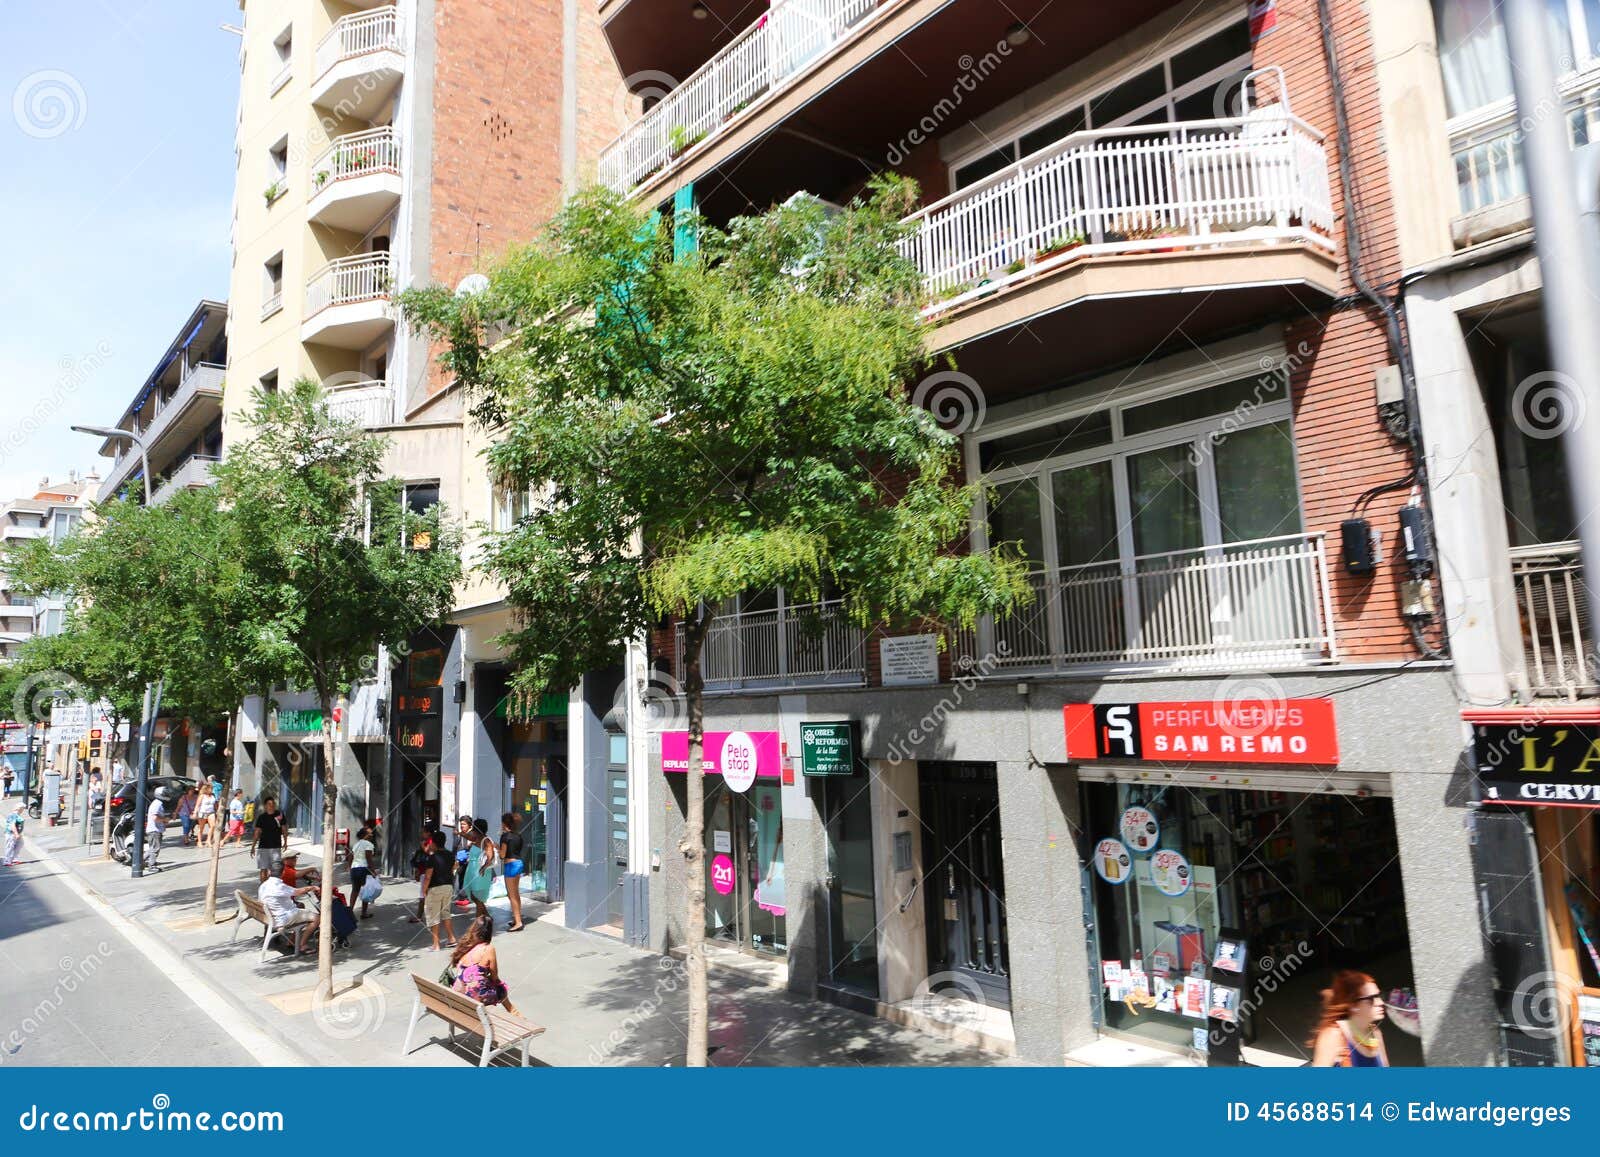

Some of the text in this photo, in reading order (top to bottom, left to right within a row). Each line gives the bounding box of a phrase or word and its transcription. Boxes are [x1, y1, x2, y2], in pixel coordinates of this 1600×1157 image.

[1153, 708, 1304, 727] PERFUMERIES
[815, 738, 849, 746] REFORMES
[1154, 735, 1308, 754] SAN REMO
[727, 744, 749, 758] Pelo
[727, 757, 749, 773] stop
[714, 864, 732, 882] 2x1
